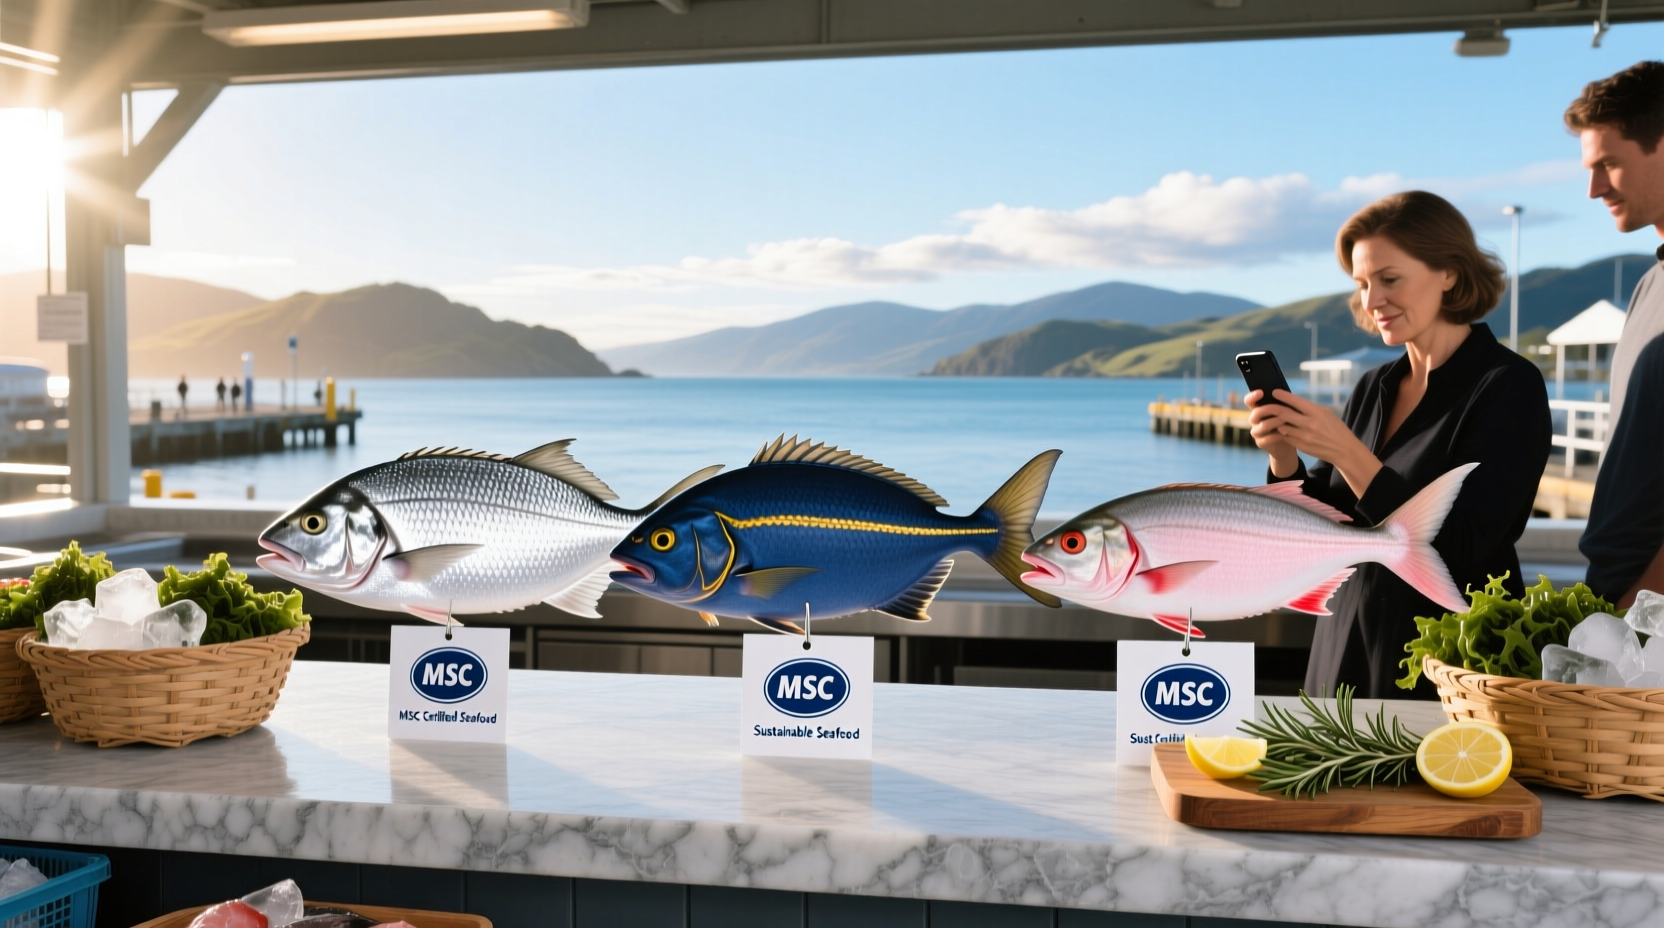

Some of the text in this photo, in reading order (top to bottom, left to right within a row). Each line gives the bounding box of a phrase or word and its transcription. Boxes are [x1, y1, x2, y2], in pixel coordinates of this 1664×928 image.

[422, 663, 473, 686] MSC
[777, 675, 834, 700] MSC
[1155, 681, 1214, 706] MSC
[399, 710, 420, 721] MSC
[754, 725, 813, 738] Sustainable
[1130, 733, 1153, 744] Sust
